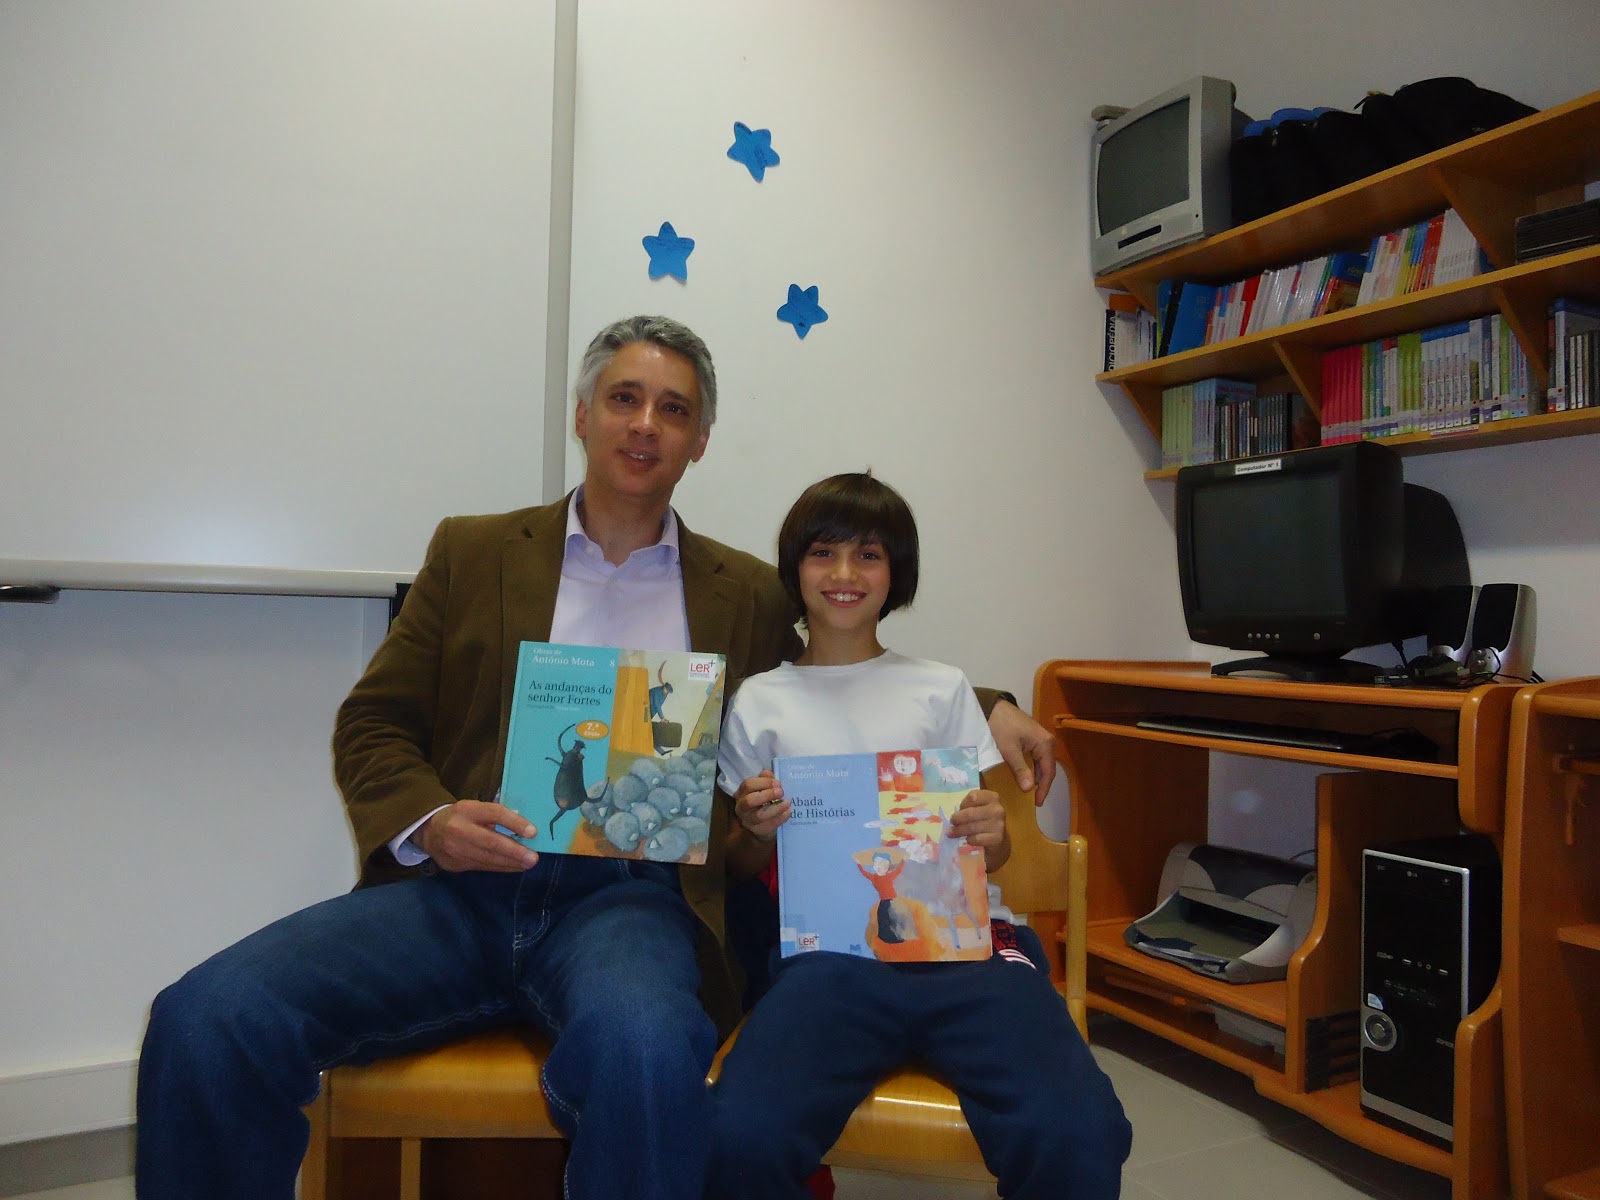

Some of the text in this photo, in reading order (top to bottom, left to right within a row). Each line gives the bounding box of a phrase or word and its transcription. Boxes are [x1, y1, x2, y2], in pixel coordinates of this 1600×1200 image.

[533, 647, 553, 655] Obras
[533, 655, 616, 668] António Mota 8
[529, 680, 612, 695] As andanças do
[527, 692, 601, 706] senhor Fortes
[826, 769, 849, 778] Mota
[790, 796, 823, 807] Abada
[790, 807, 856, 819] de Histórias
